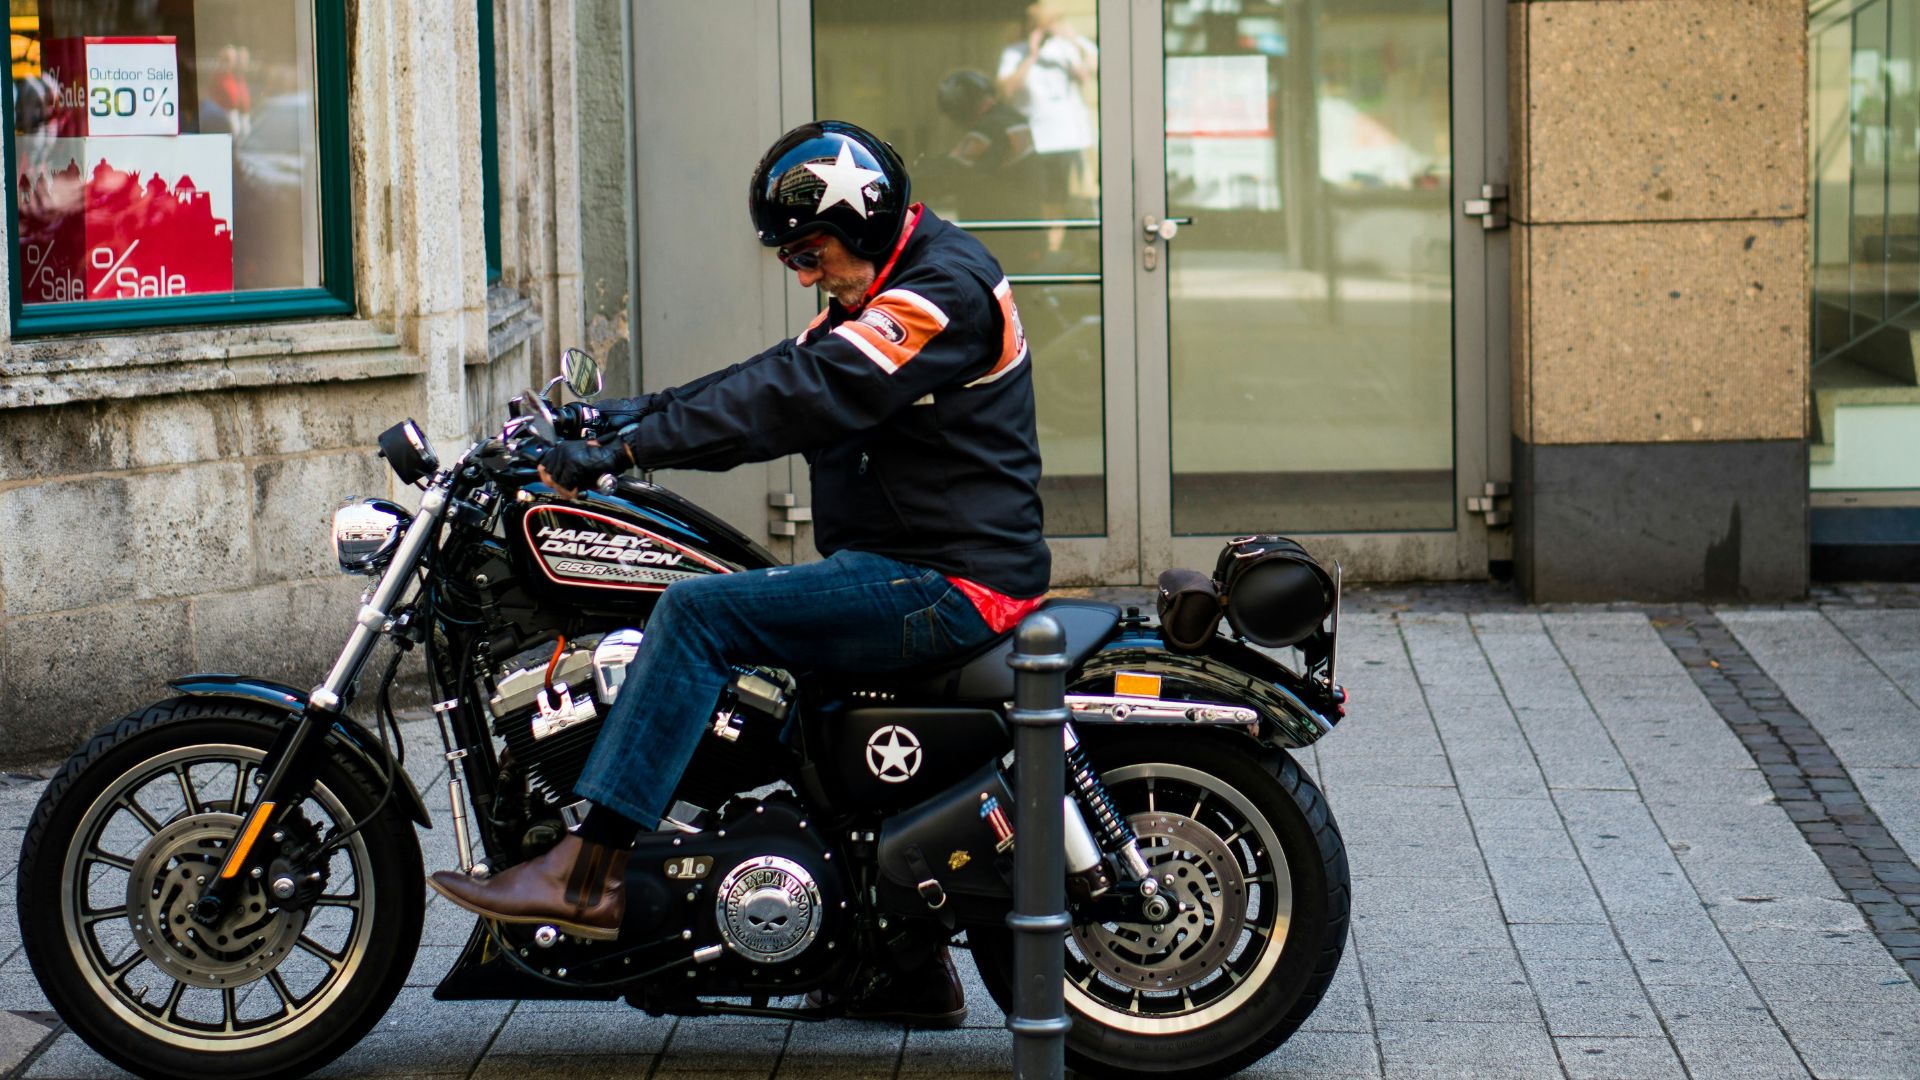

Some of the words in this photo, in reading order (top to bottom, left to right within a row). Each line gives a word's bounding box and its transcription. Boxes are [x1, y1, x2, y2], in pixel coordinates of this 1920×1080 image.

[89, 68, 143, 80] Outdoor
[147, 67, 174, 80] Sale
[58, 80, 85, 108] Sale
[41, 266, 84, 302] Sale
[116, 265, 186, 300] Sale
[536, 526, 652, 549] HARLEY-
[540, 540, 683, 566] DAVIDSON
[556, 560, 608, 575] 883R
[677, 857, 697, 879] 1
